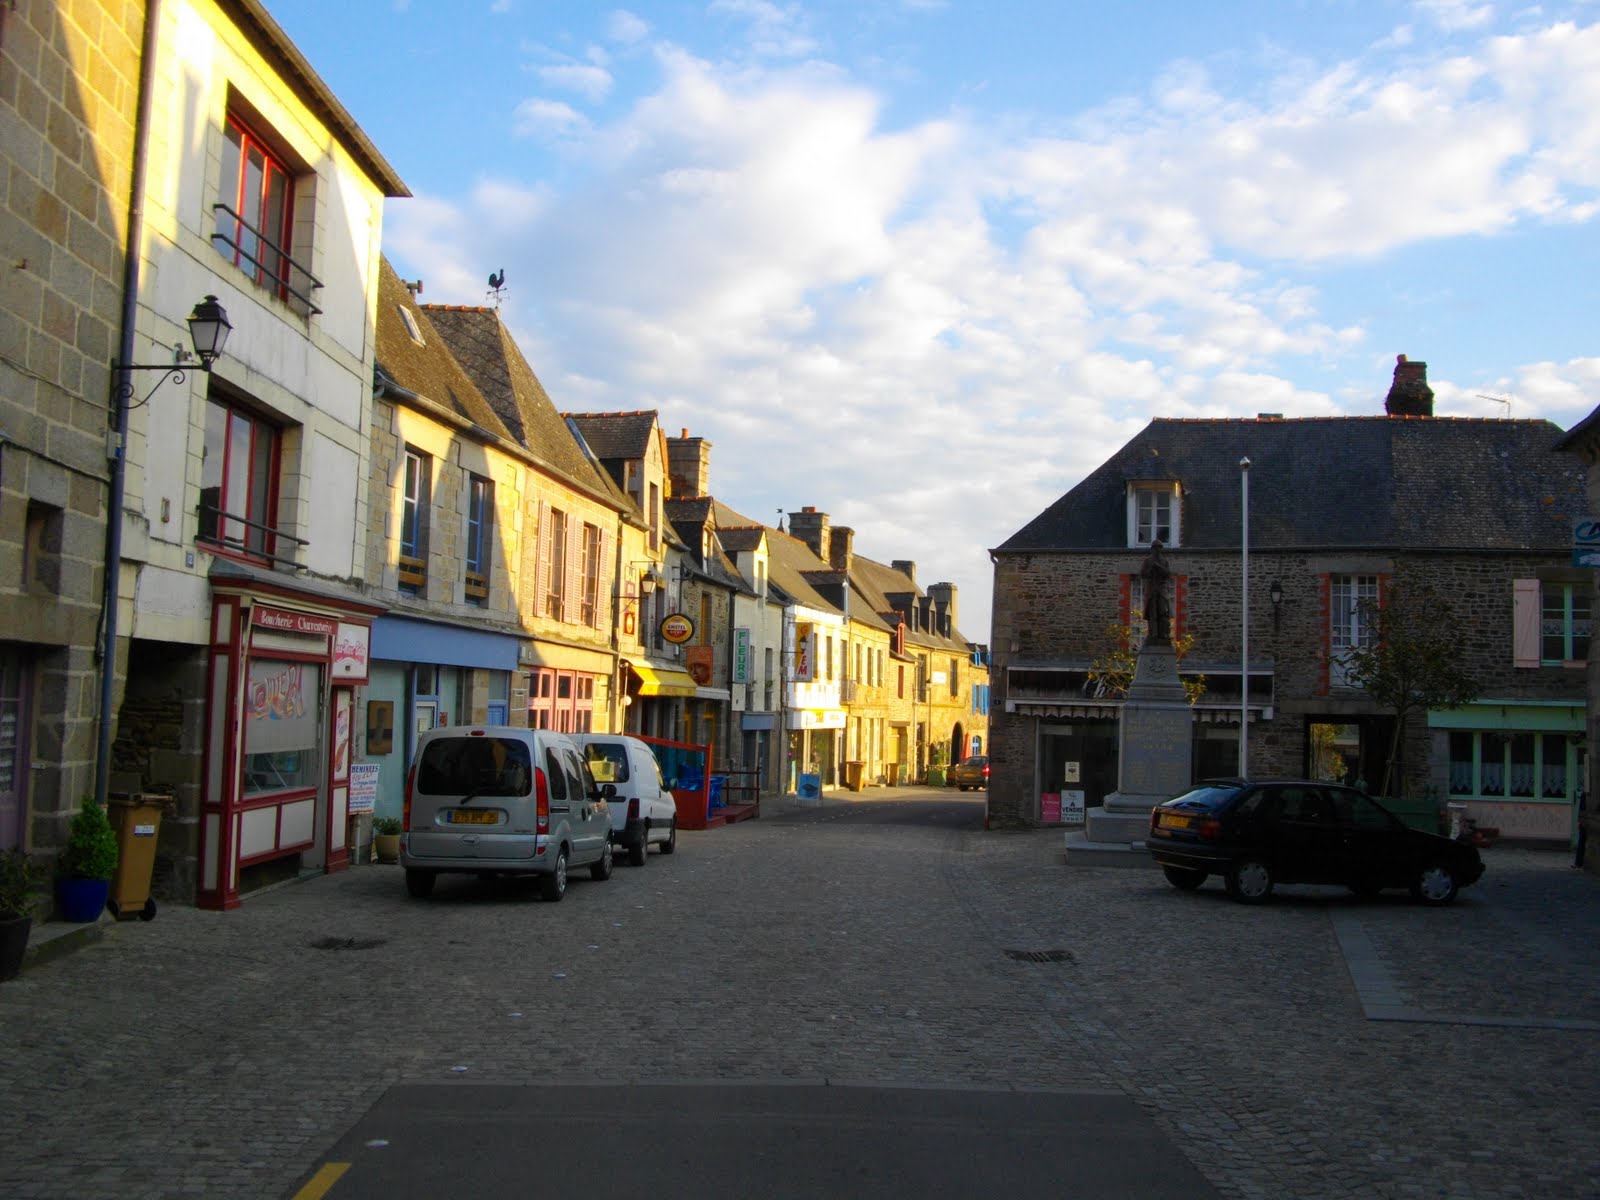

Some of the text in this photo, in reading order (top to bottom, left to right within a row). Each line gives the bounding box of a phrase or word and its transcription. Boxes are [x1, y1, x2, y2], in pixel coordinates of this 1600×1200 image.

[261, 610, 333, 633] Boucherie Charcuterie
[737, 632, 746, 680] FLEURS
[798, 625, 808, 676] GEM
